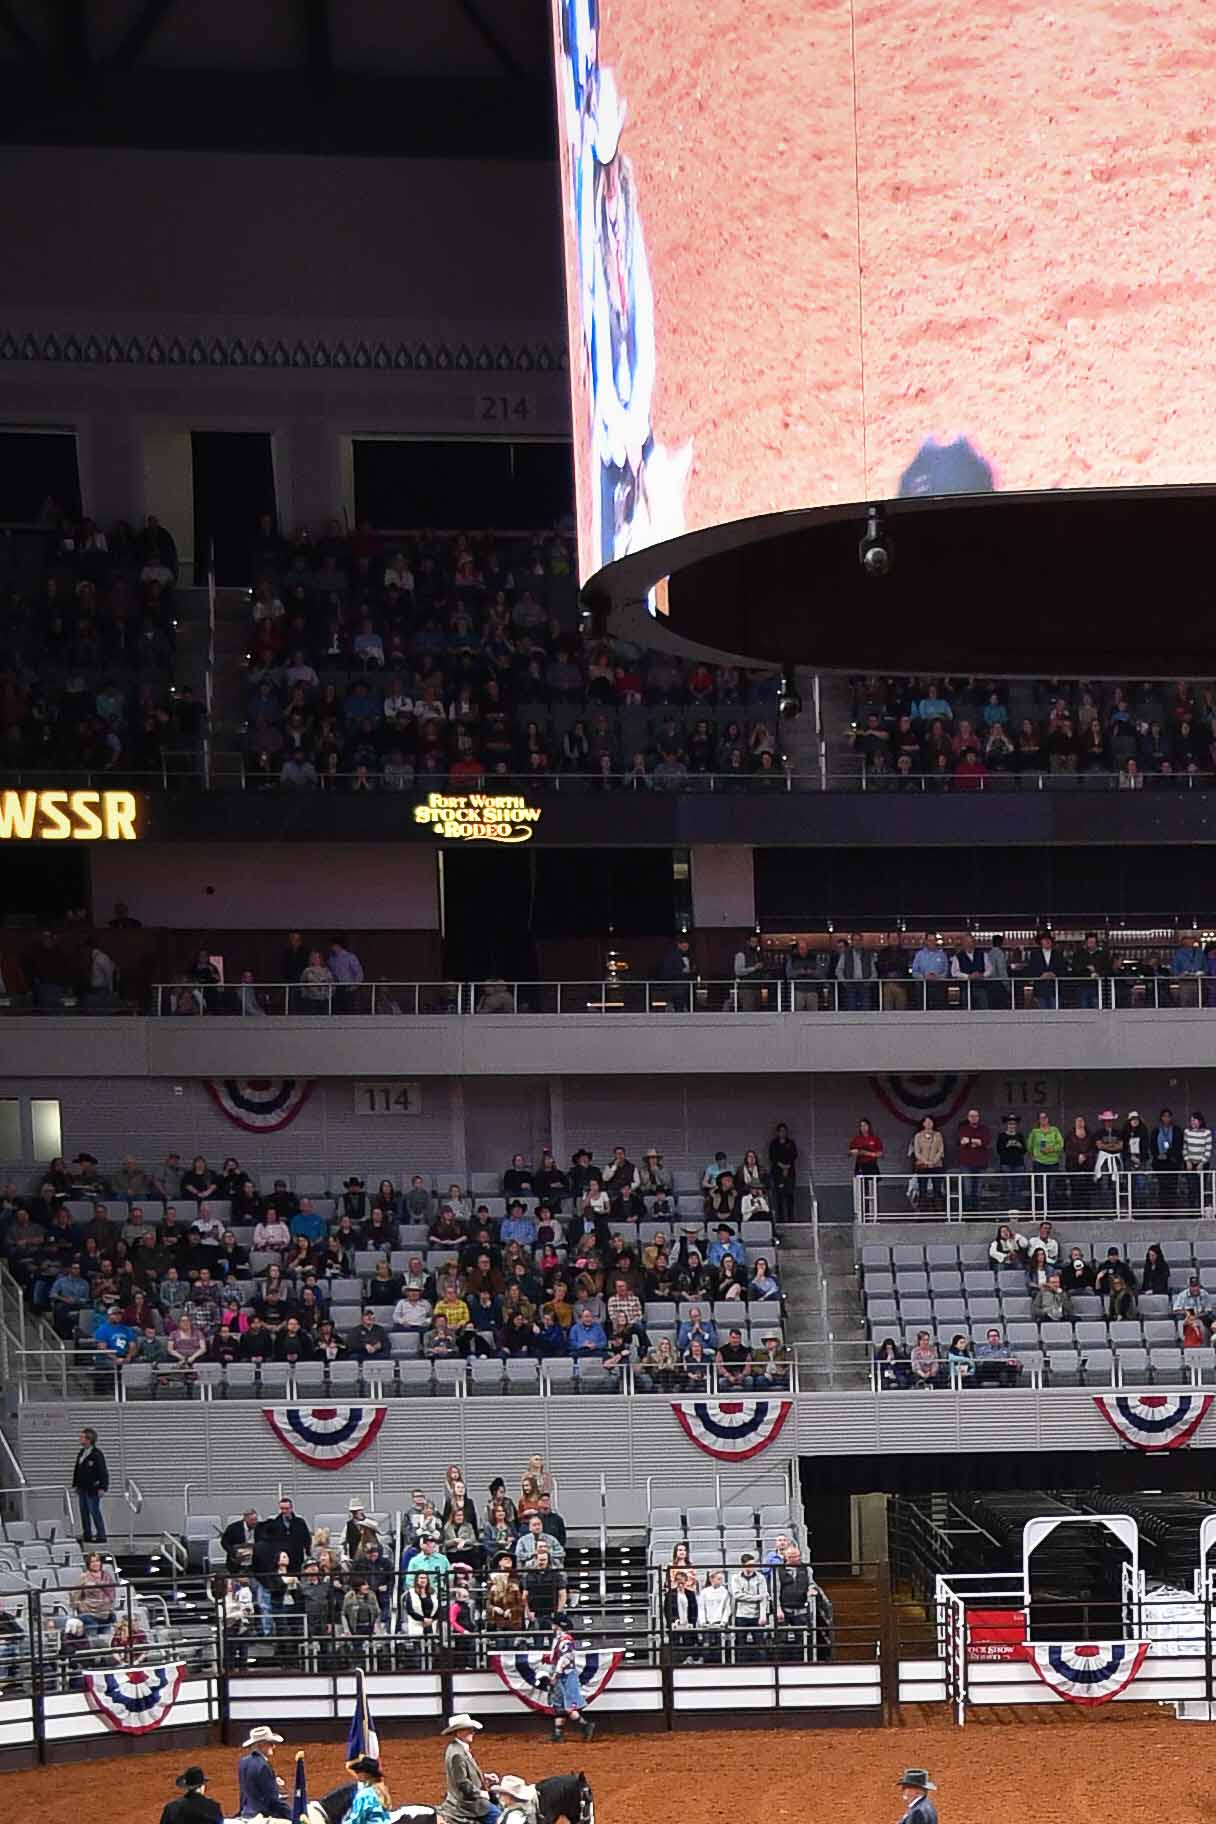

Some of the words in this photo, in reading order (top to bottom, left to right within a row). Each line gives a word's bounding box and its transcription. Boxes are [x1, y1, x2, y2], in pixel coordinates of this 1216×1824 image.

[480, 396, 530, 420] 214
[428, 793, 468, 809] FORT
[469, 794, 525, 809] WORTH
[414, 806, 481, 823] STOCK
[482, 807, 541, 823] SHOW
[444, 821, 512, 838] RODEO
[363, 1088, 413, 1111] 114
[1003, 1081, 1048, 1104] 115
